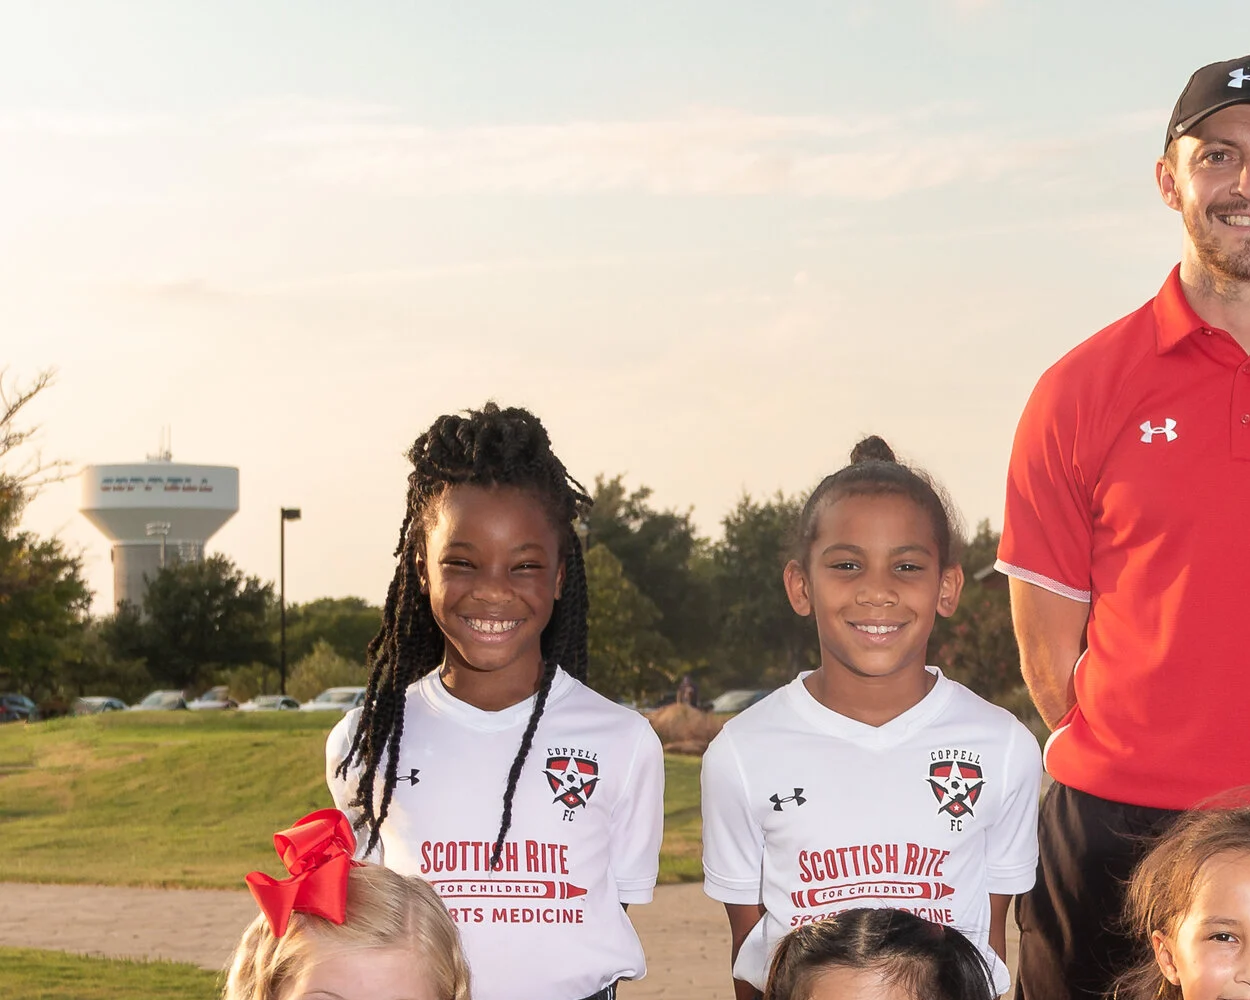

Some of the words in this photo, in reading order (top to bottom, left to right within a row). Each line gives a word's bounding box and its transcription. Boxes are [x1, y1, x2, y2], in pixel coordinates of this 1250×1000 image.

[547, 748, 598, 762] COPPELL
[930, 749, 980, 765] COPPELL
[562, 809, 576, 822] FC
[950, 819, 963, 832] FC
[525, 840, 569, 875] RITE
[799, 844, 898, 883] SCOTTISH
[904, 843, 950, 877] RITE
[440, 885, 463, 893] FOR
[470, 884, 539, 893] CHILDREN
[822, 889, 843, 900] FOR
[849, 886, 915, 895] CHILDREN
[449, 908, 484, 923] RTS
[491, 908, 583, 924] MEDICINE
[790, 909, 848, 926] SPOR
[900, 908, 954, 923] ICINE
